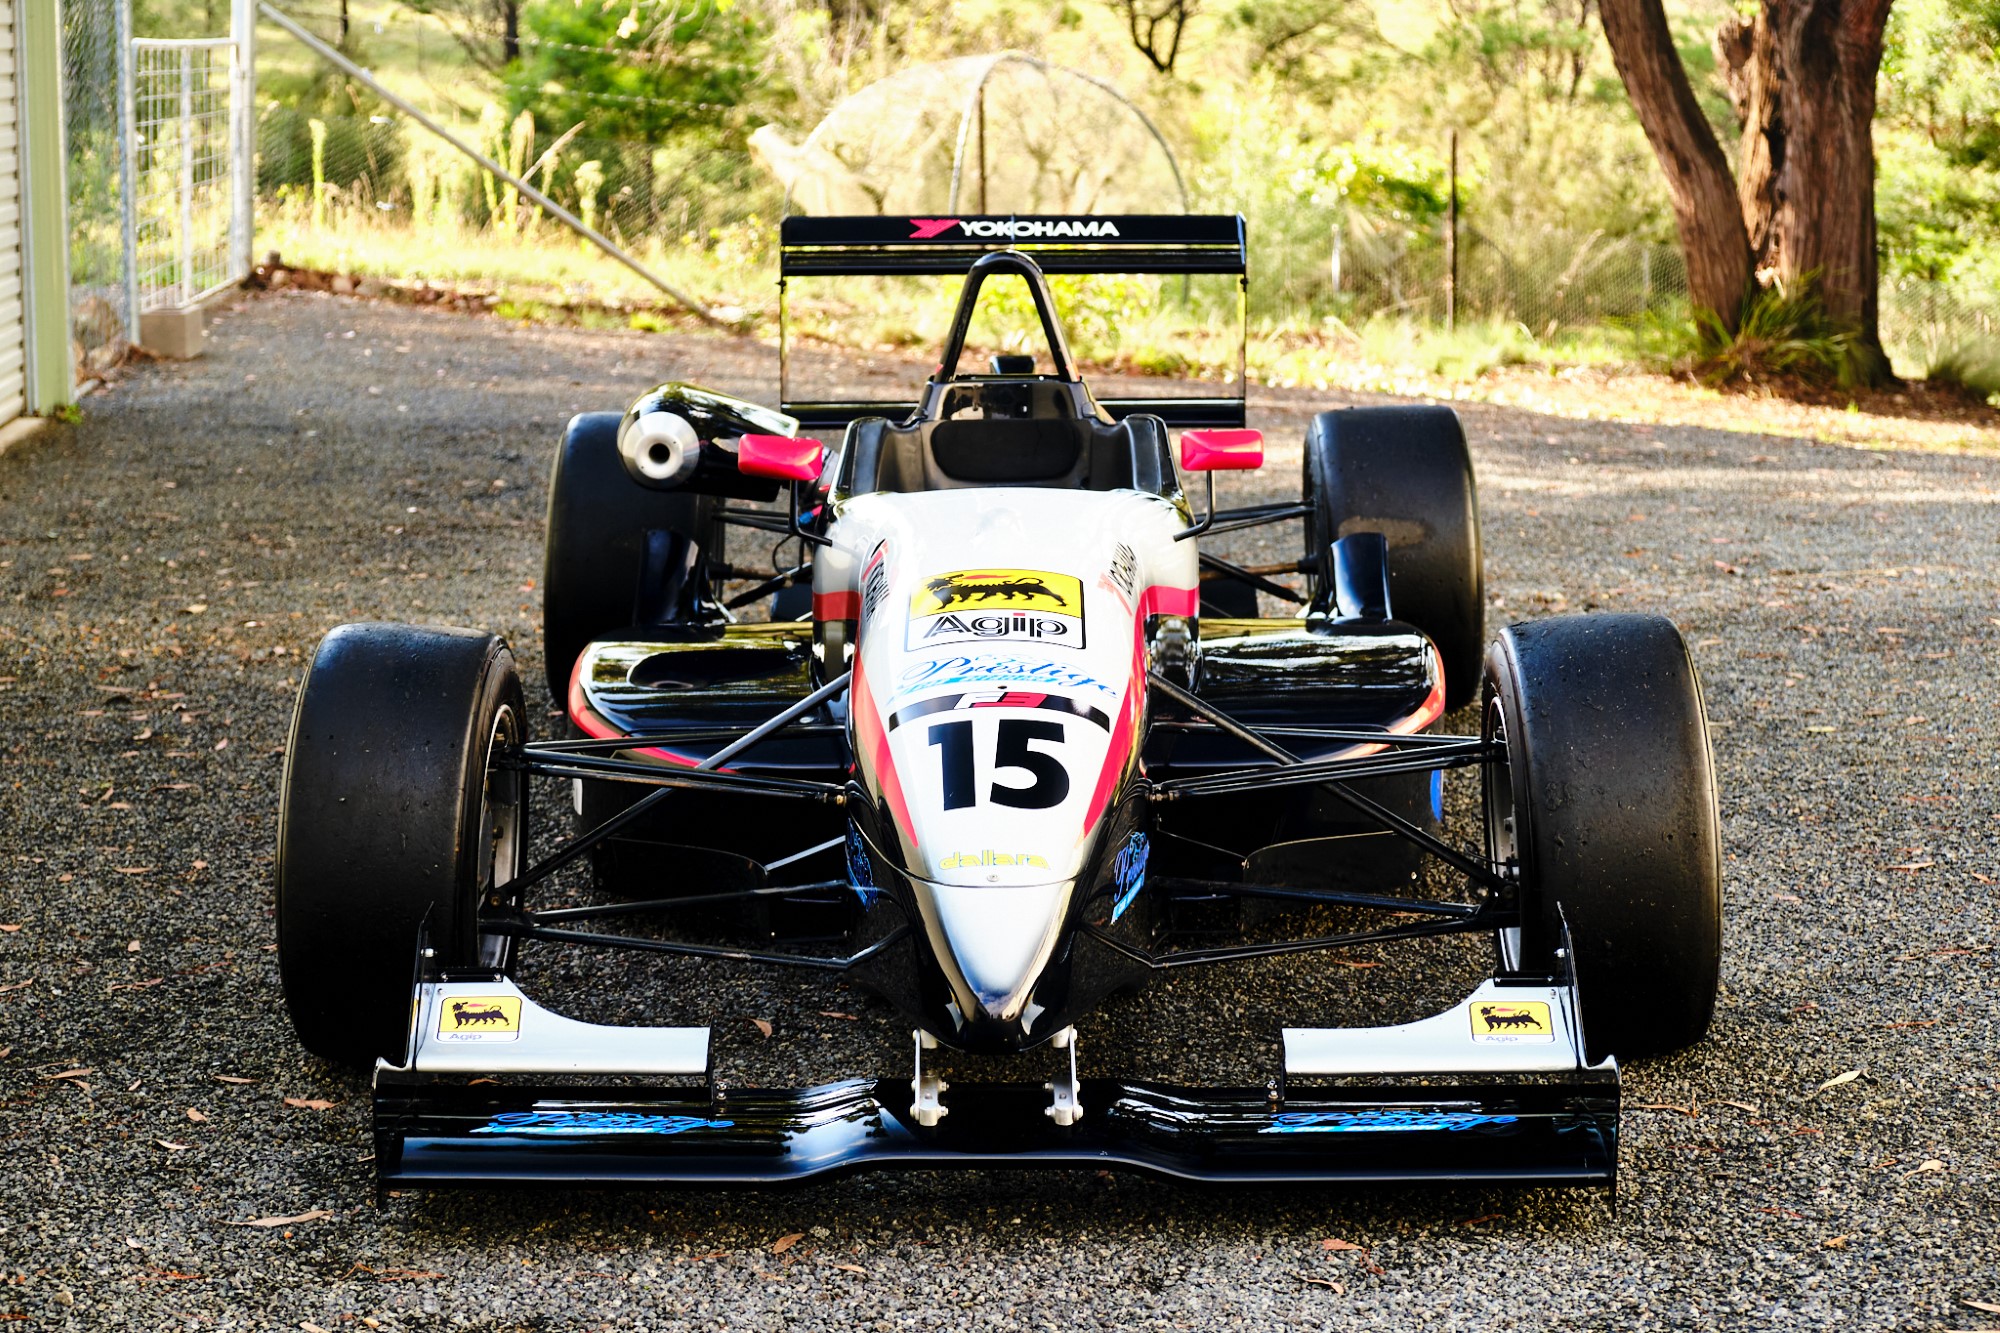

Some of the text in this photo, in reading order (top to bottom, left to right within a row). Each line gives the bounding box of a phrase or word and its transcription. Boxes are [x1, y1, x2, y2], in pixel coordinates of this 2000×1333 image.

[959, 220, 1120, 237] YOKOHAMA
[923, 612, 1068, 638] Agip
[898, 655, 1118, 699] Prestige
[954, 690, 1049, 710] F3
[928, 718, 1070, 811] 15
[939, 849, 1052, 871] dallara
[449, 1033, 482, 1041] Agip
